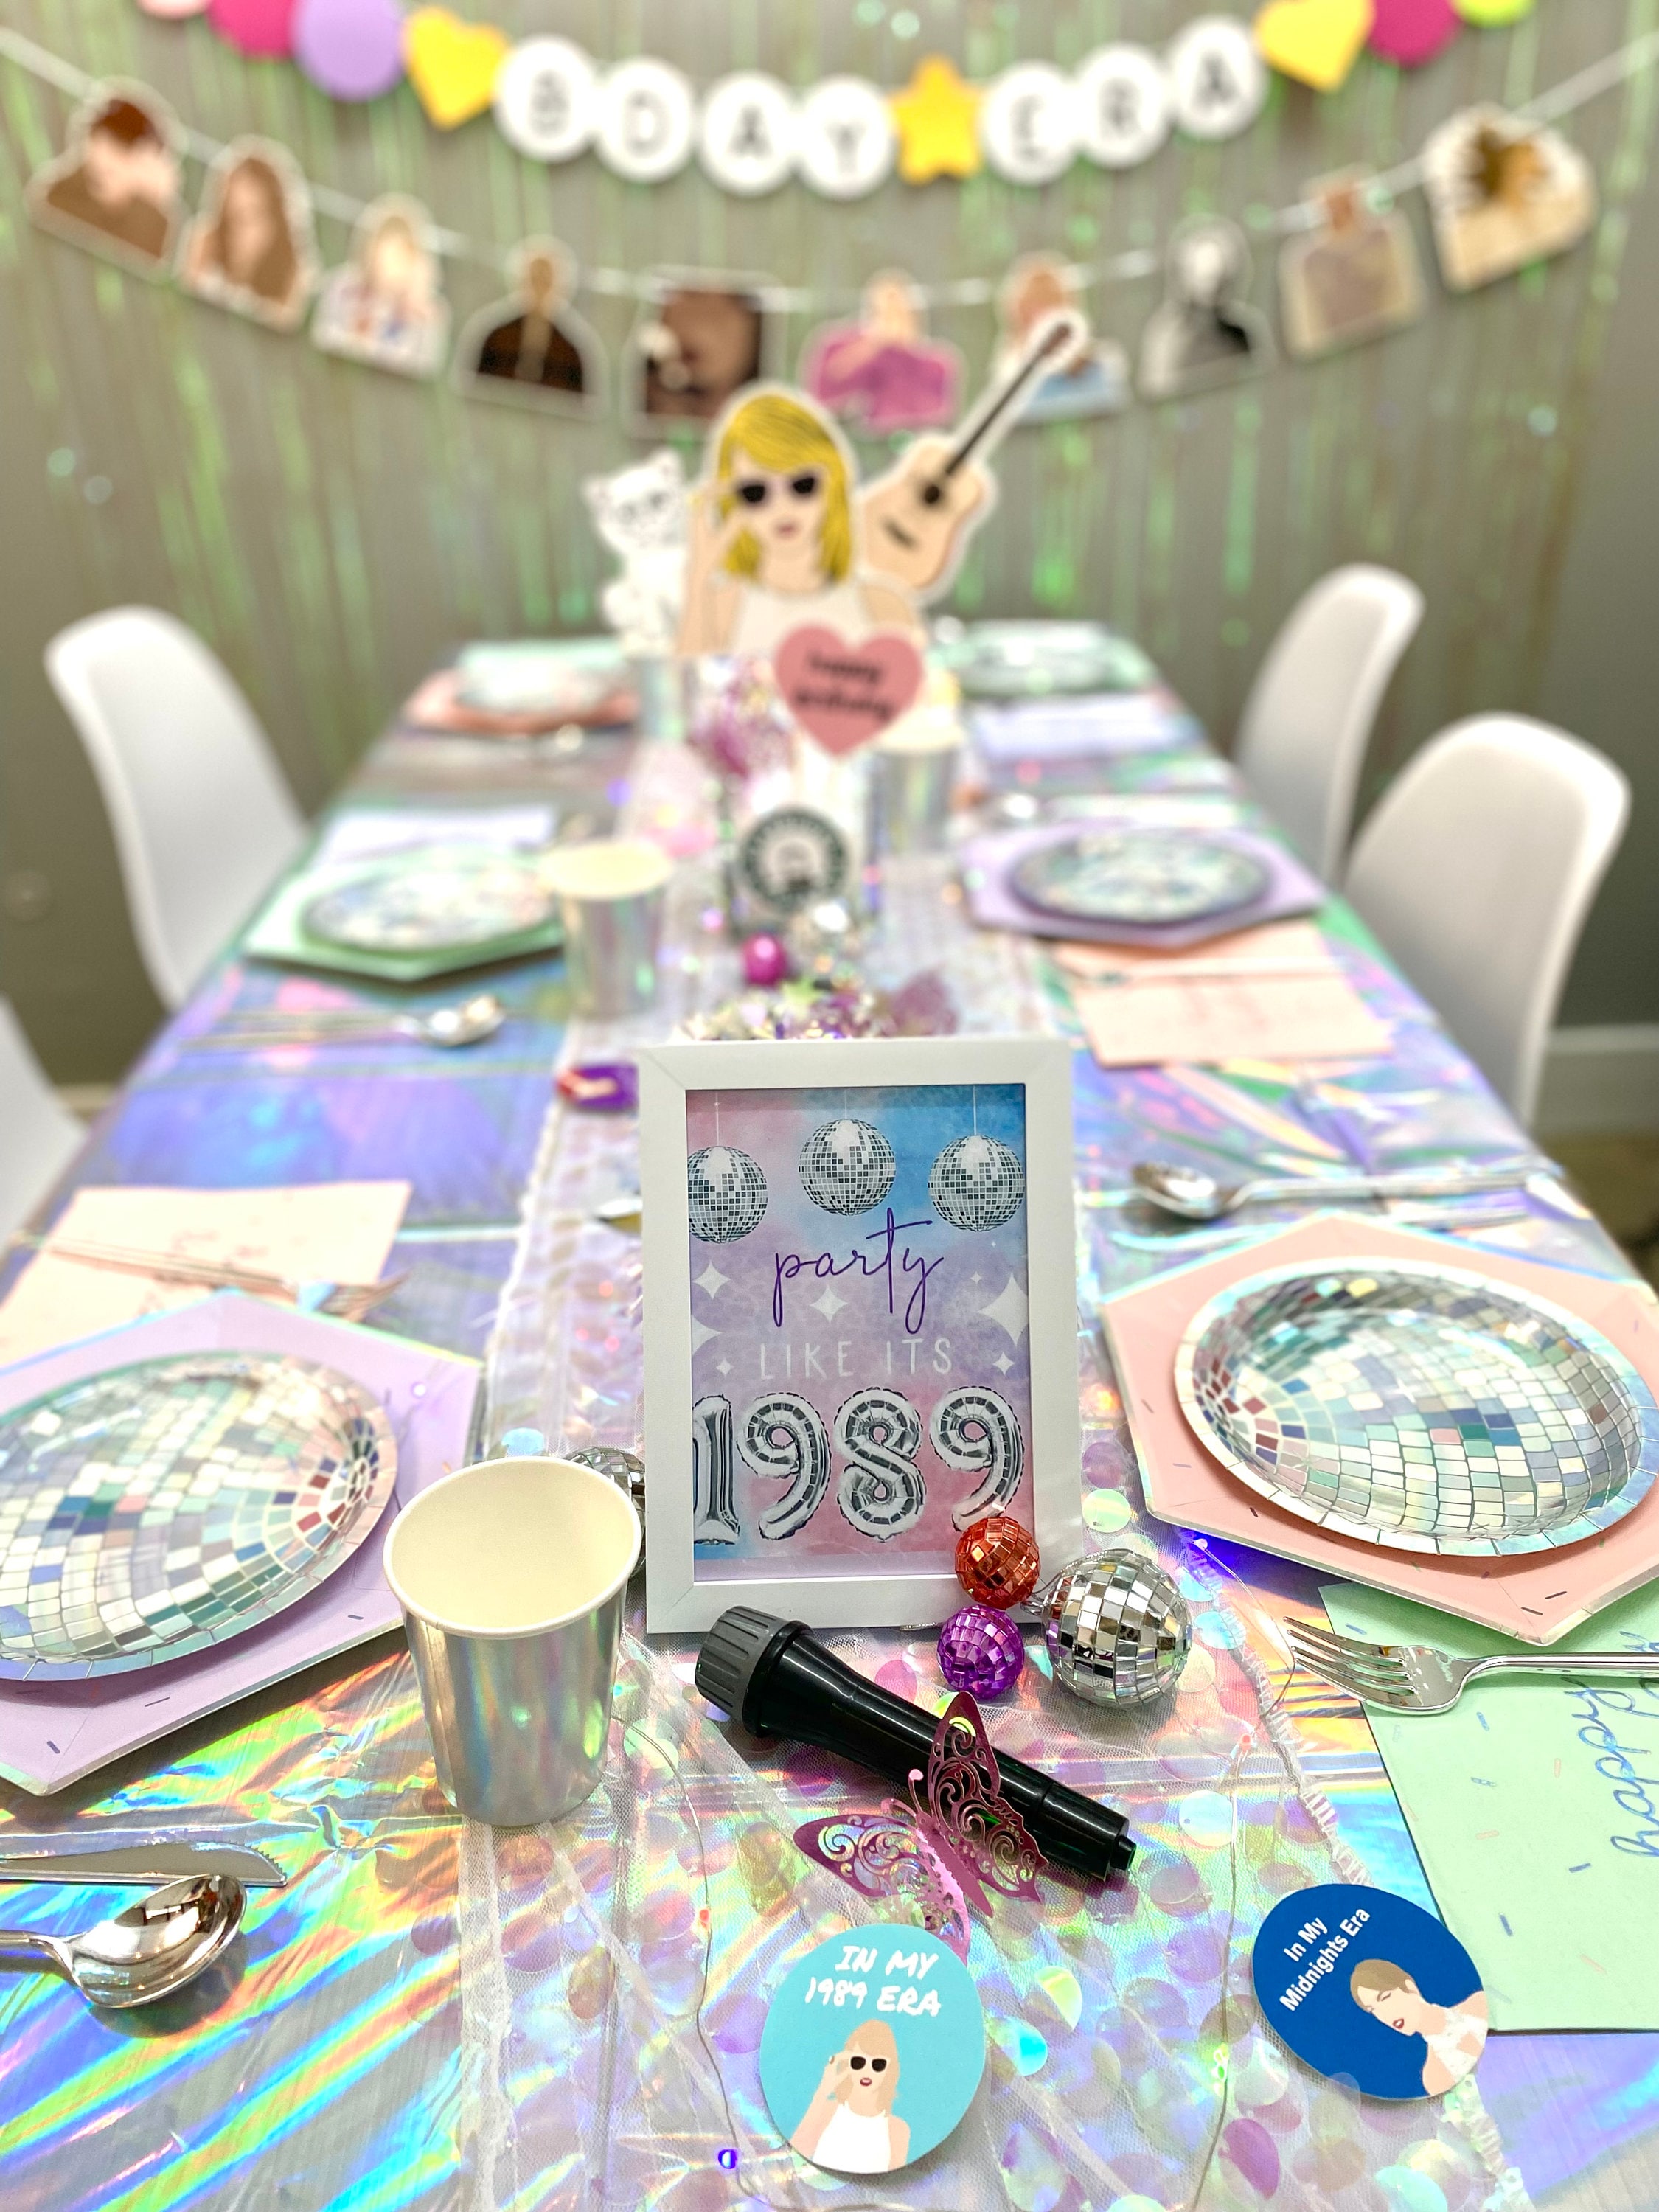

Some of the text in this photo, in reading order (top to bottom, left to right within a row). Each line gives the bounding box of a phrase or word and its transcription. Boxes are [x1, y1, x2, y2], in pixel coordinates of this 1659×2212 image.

[1011, 55, 1232, 159] ERA
[773, 1207, 944, 1334] party
[759, 1338, 953, 1380] LIKE ITS
[693, 1386, 1025, 1546] 1989
[835, 1945, 939, 1980] IN MY
[1279, 1908, 1371, 2011] Midnights Era
[1284, 1917, 1328, 1961] In My
[804, 1977, 942, 2017] 1989 ERA
